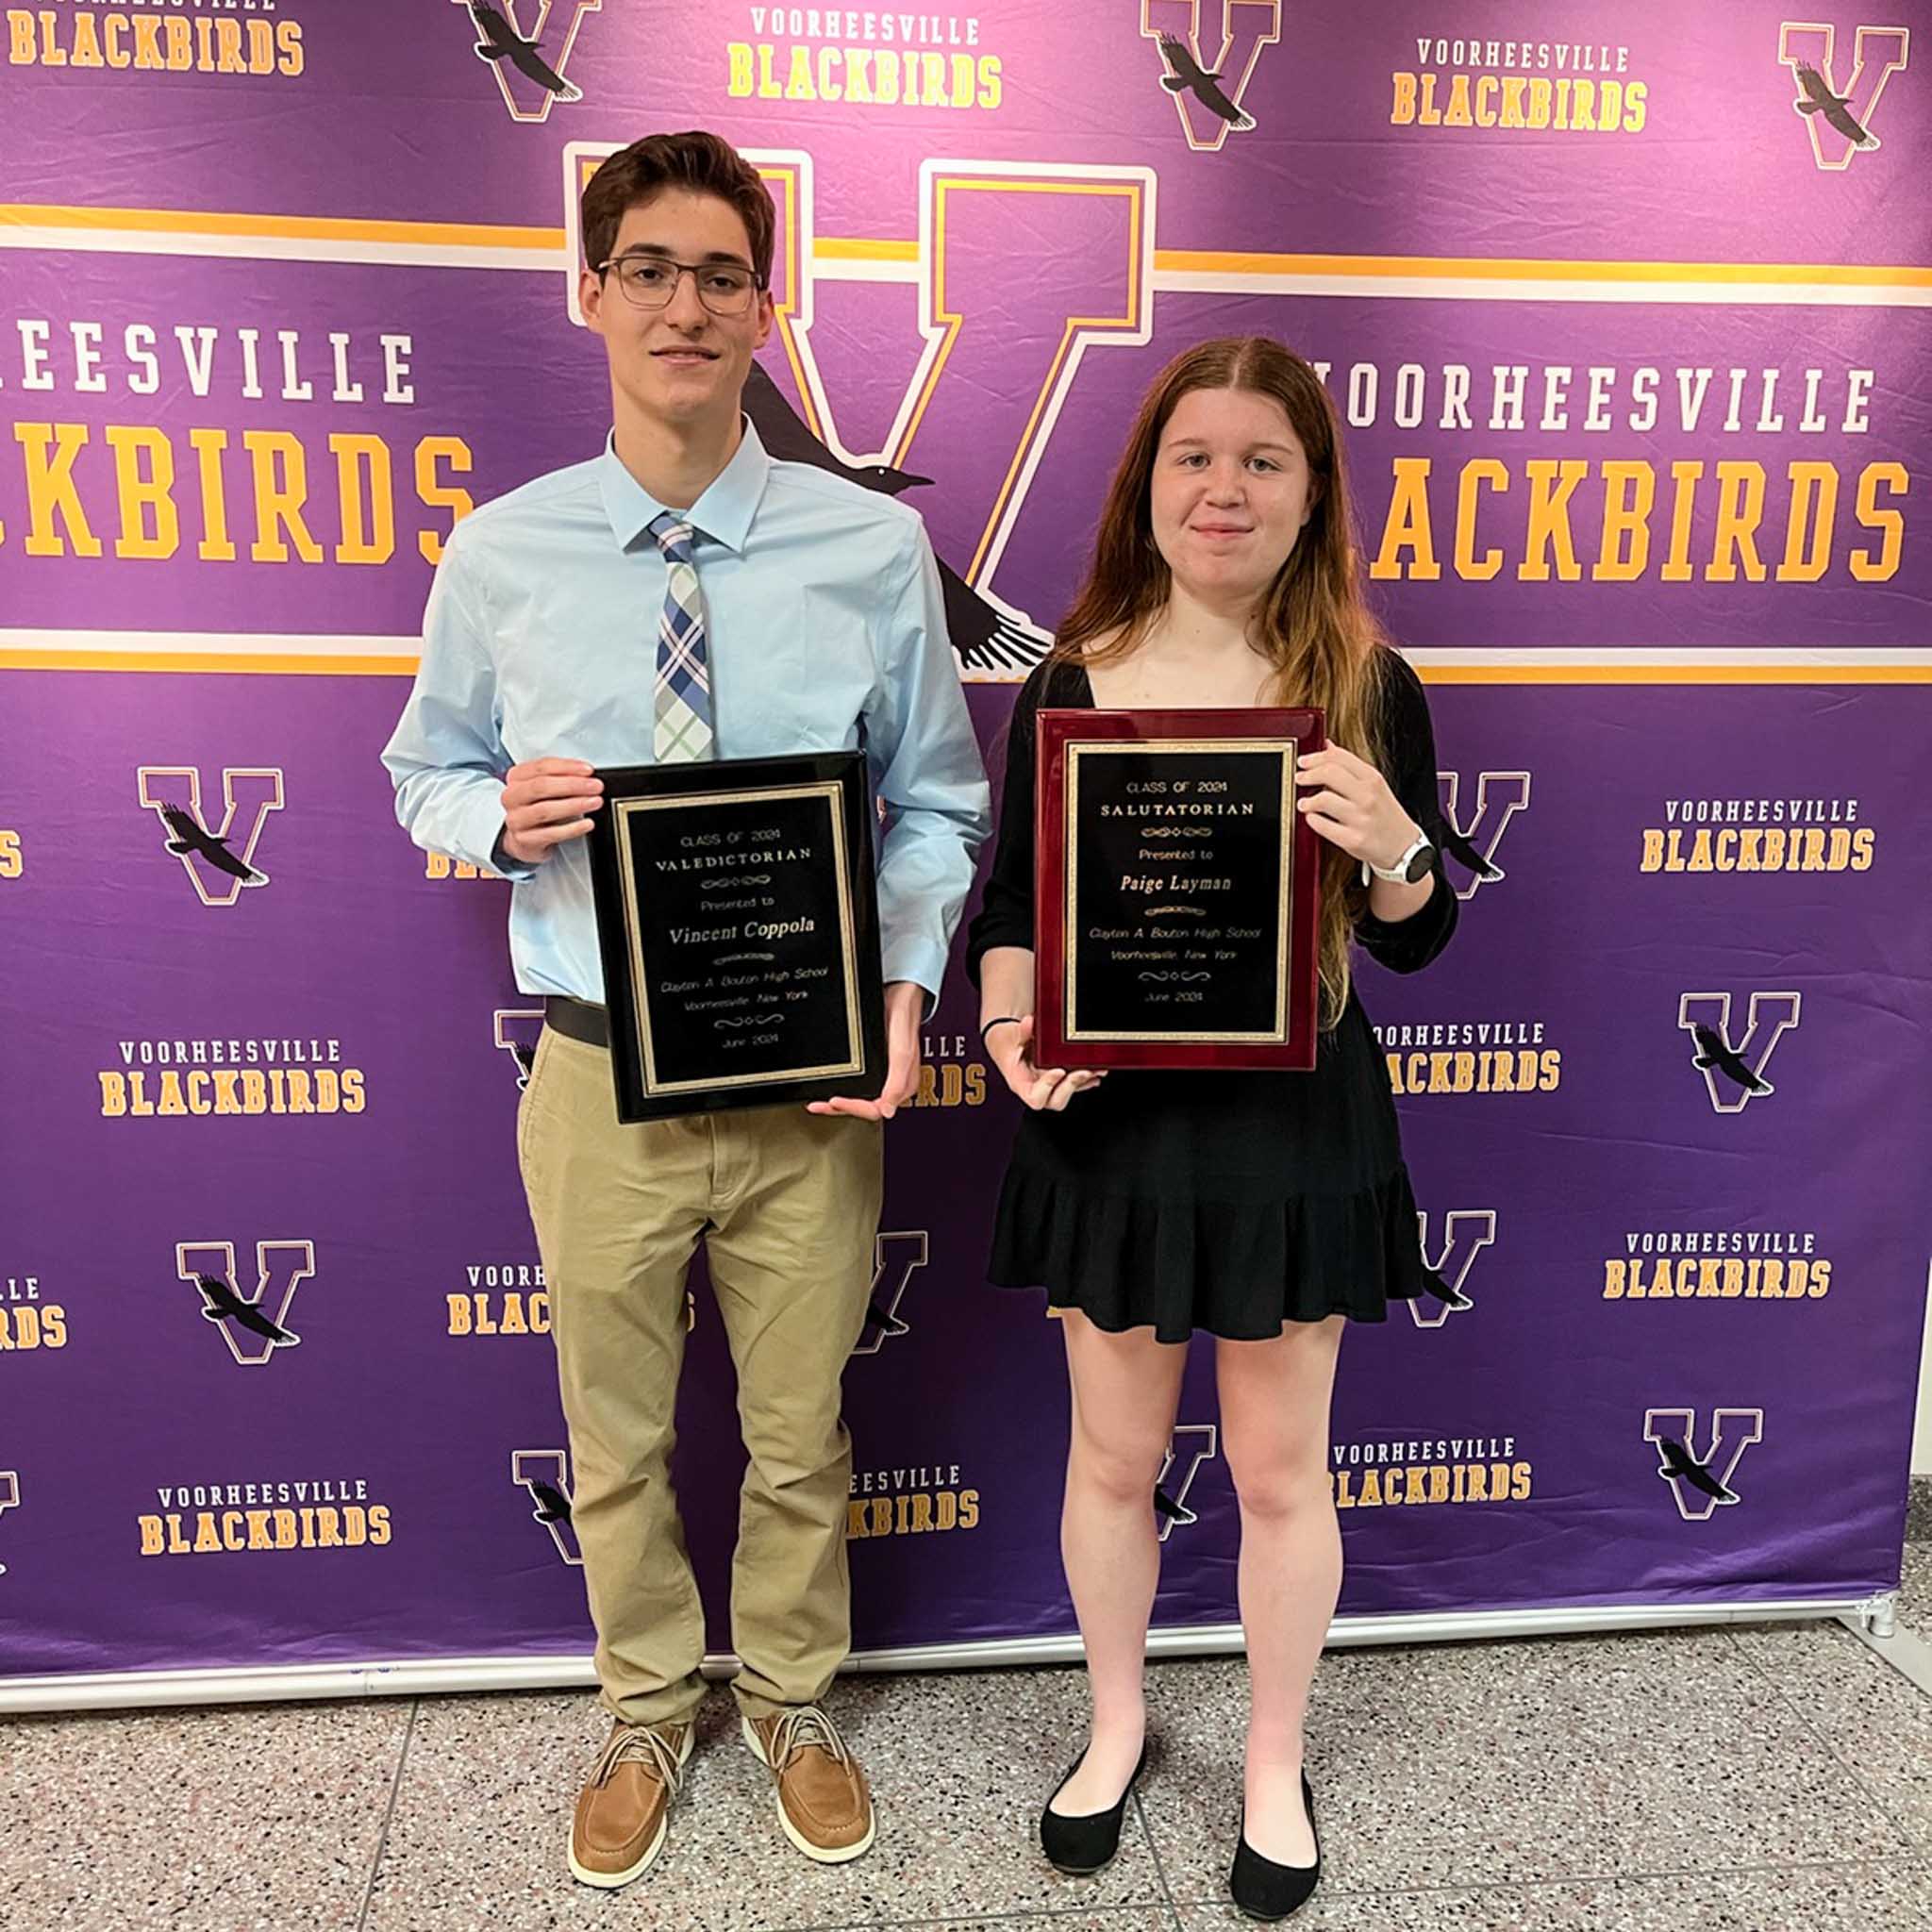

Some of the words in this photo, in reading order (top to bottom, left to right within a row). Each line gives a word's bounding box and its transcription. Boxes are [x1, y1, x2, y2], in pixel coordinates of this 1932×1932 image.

[752, 8, 979, 45] VOORHEESVILLE
[7, 9, 305, 76] BLACKBIRDS
[1417, 39, 1629, 72] VOORHEESVILLE
[727, 43, 1003, 108] BLACKBIRDS
[1391, 73, 1648, 132] BLACKBIRDS
[0, 319, 415, 404] EESVILLE
[0, 422, 474, 566] KBIRDS
[1126, 781, 1167, 793] CLASS
[1173, 781, 1191, 793] OF
[1197, 781, 1227, 793] 2024
[1100, 803, 1254, 817] SALUTATORIAN
[1665, 800, 1858, 823] VOORHEESVILLE
[680, 833, 722, 848] CLASS
[726, 831, 743, 844] OF
[751, 828, 781, 842] 2024
[1640, 828, 1875, 873] BLACKBIRDS
[656, 847, 811, 872] VALEDICTORIAN
[1139, 849, 1195, 860] Presented
[1200, 850, 1214, 860] to
[1120, 875, 1163, 894] Paige
[1170, 875, 1232, 894] Layman
[701, 898, 757, 911] Presented
[761, 897, 775, 907] to
[669, 925, 738, 944] Vincent
[744, 916, 815, 941] Coppola
[1089, 927, 1129, 941] Clayton
[1150, 926, 1190, 939] Bouton
[1194, 927, 1221, 941] High
[1226, 926, 1262, 940] School
[1184, 949, 1207, 959] New
[764, 971, 790, 982] High
[794, 966, 828, 980] School
[120, 1041, 341, 1064] VOORHEESVILLE
[98, 1070, 367, 1116] BLACKBIRDS
[1626, 1233, 1815, 1255] VOORHEESVILLE
[1603, 1259, 1832, 1300] BLACKBIRDS
[1333, 1438, 1515, 1465] VOORHEESVILLE
[158, 1481, 367, 1508] VOORHEESVILLE
[1328, 1461, 1532, 1508] LACKBIRDS
[138, 1506, 392, 1556] BLACKBIRDS
